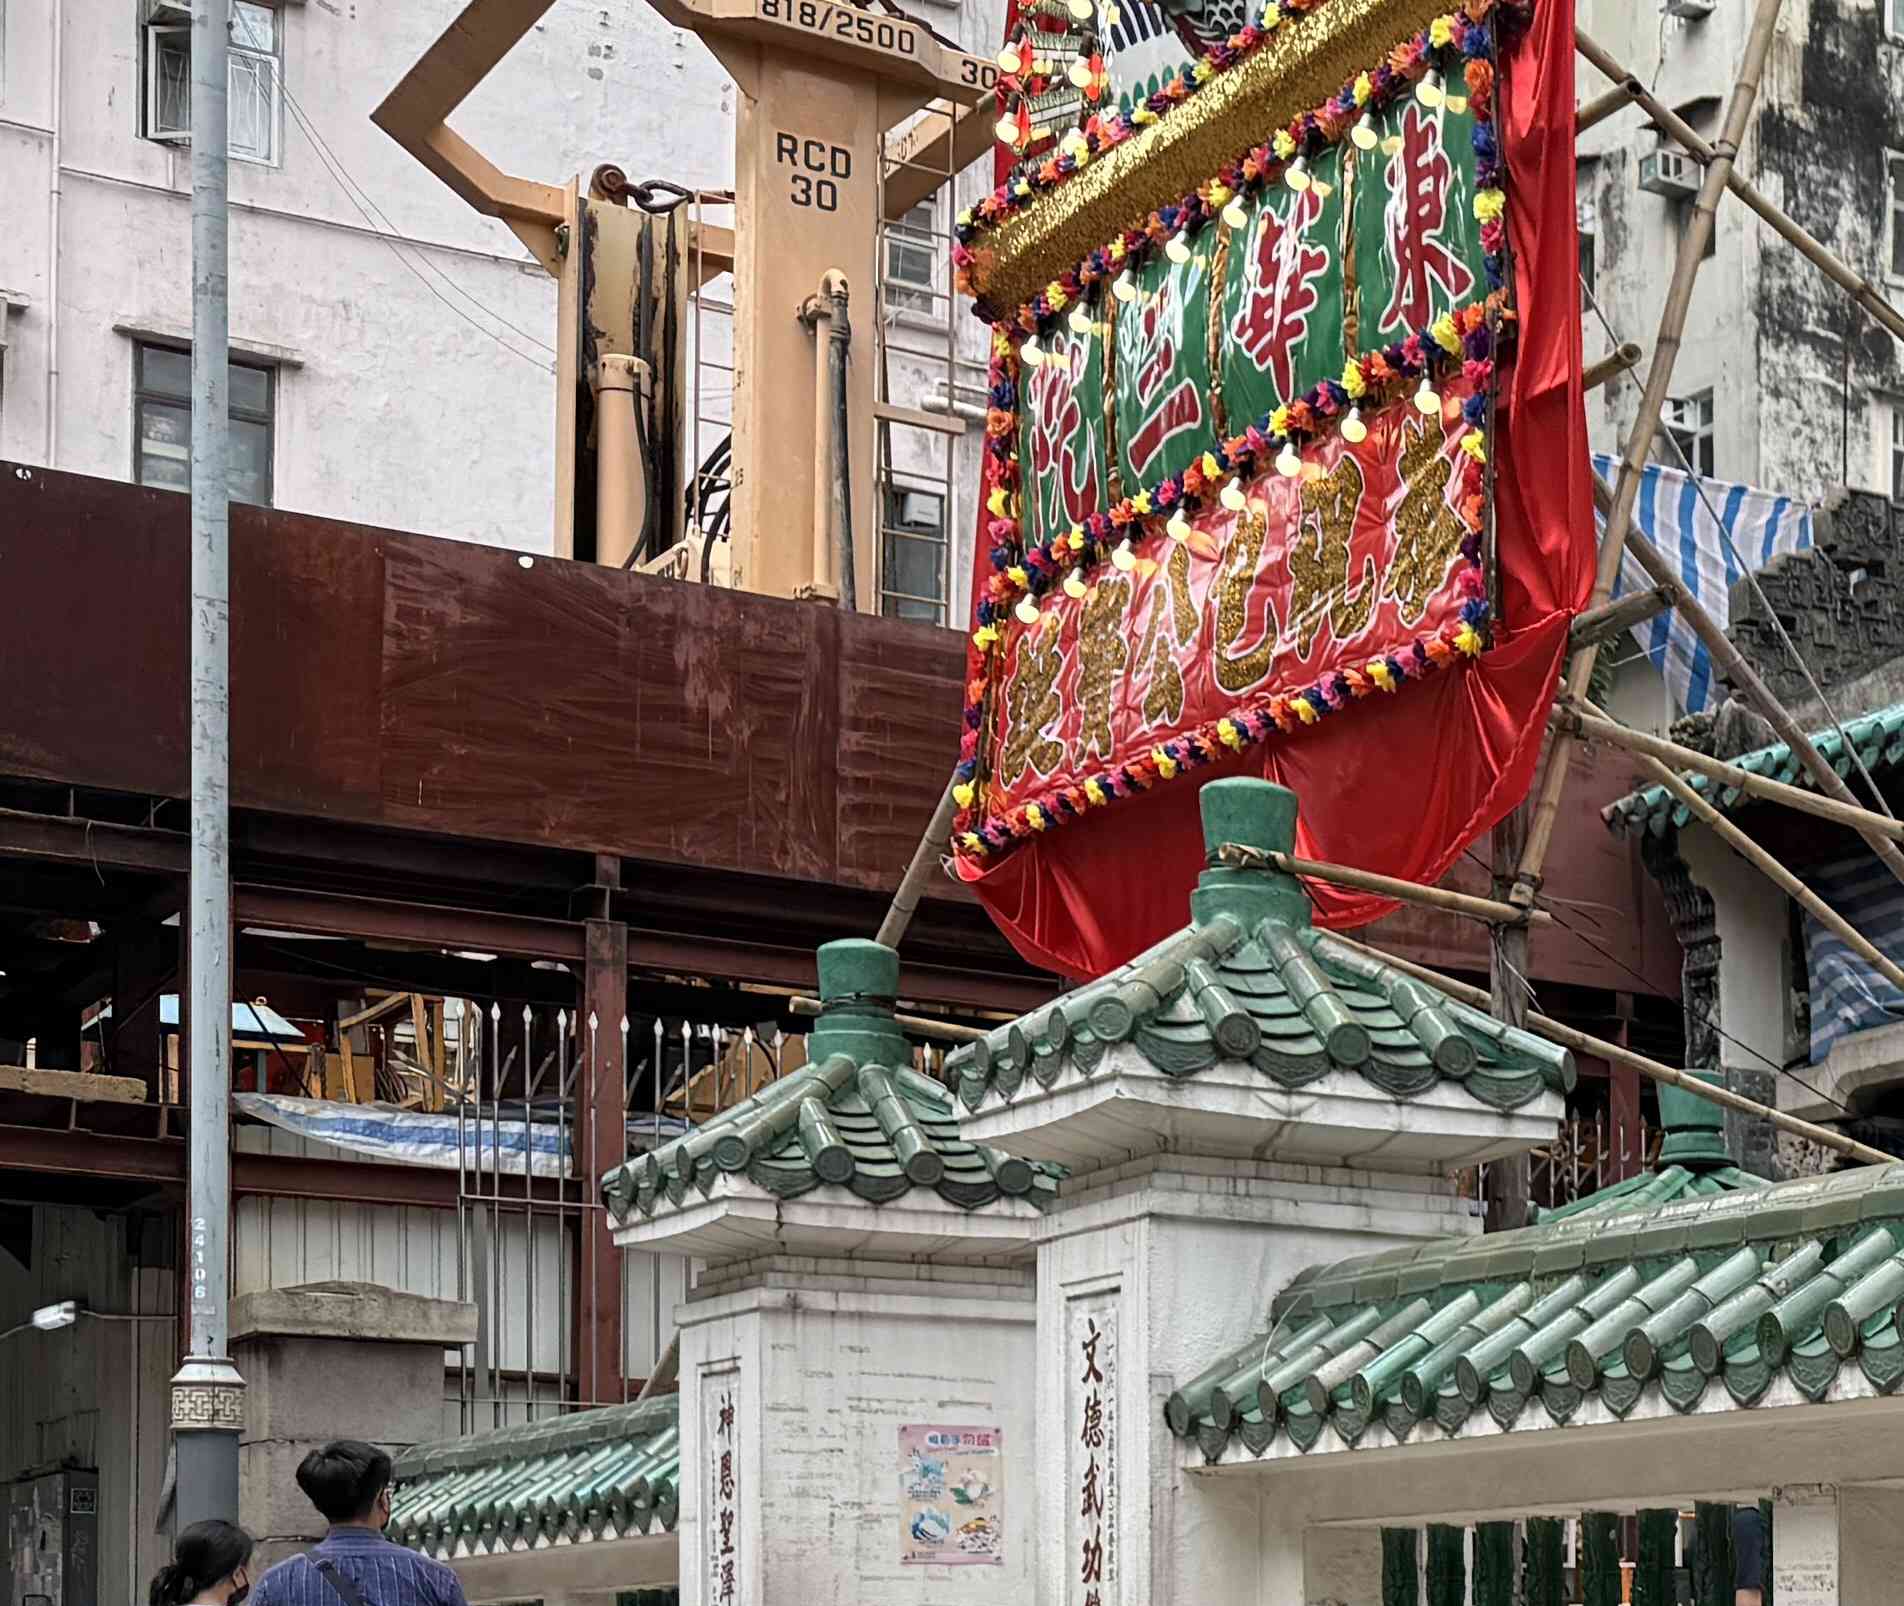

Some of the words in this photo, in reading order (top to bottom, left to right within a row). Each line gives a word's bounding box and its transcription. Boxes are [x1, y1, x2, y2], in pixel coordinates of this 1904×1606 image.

[762, 0, 915, 55] 818/2500
[776, 132, 851, 180] RCD
[790, 174, 838, 212] 30
